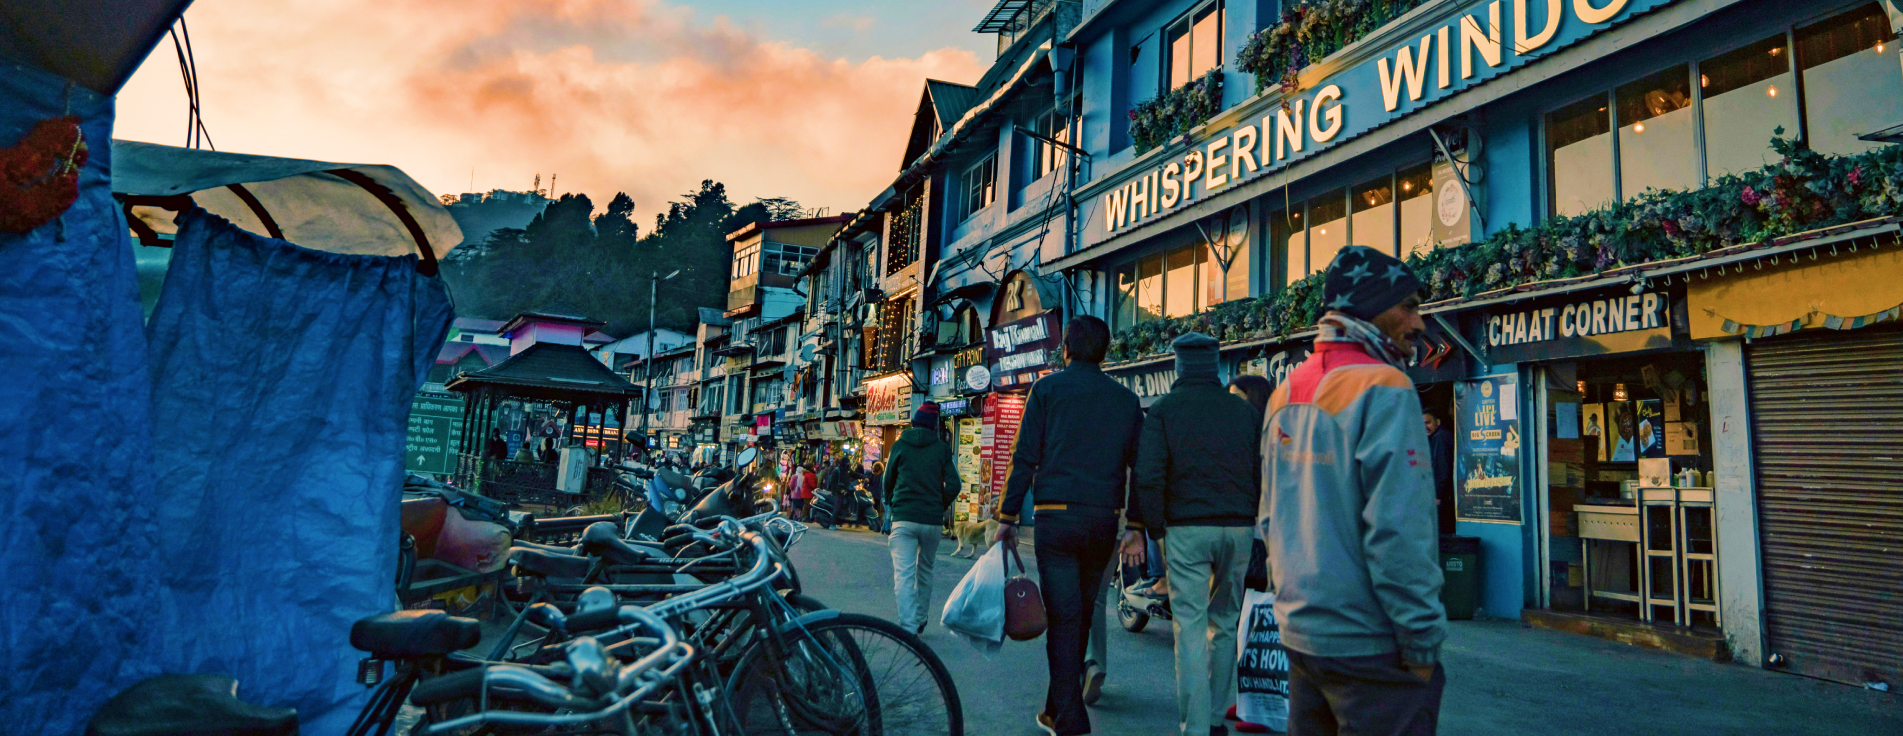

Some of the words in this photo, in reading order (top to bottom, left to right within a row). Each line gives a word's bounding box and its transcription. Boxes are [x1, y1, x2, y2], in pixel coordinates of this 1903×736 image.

[1105, 83, 1344, 232] WHISPERING
[1488, 307, 1555, 347] CHAAT
[1562, 293, 1659, 338] CORNER
[954, 352, 966, 369] CITY
[966, 347, 983, 366] POINT
[1134, 374, 1145, 397] &
[1145, 370, 1178, 396] DINI
[1475, 412, 1496, 426] LIVE
[1239, 648, 1258, 668] IT'S
[1260, 648, 1290, 672] HOW
